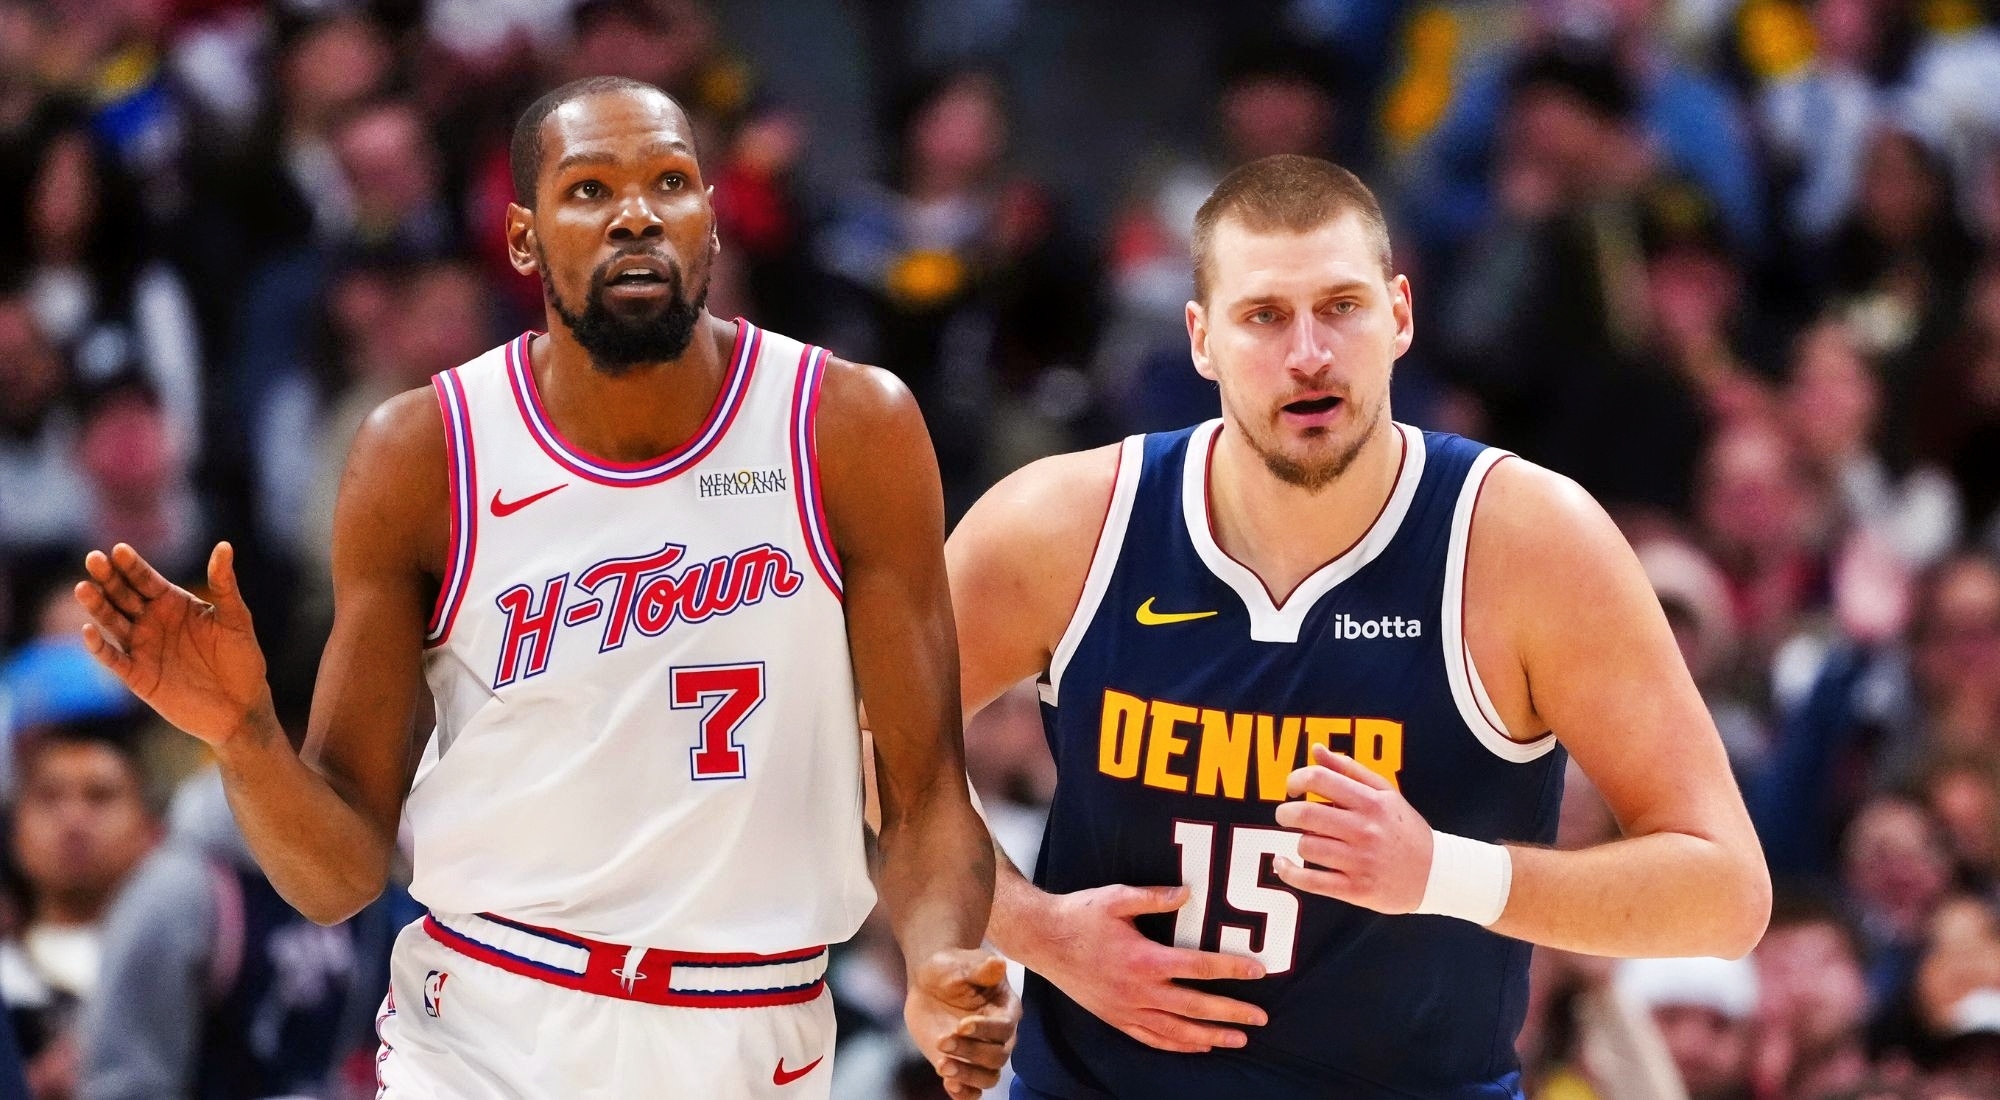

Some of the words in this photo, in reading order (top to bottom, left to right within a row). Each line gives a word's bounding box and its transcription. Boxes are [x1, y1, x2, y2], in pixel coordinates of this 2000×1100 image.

[700, 468, 786, 487] MEMORIAL
[700, 480, 786, 498] HERMANN
[493, 542, 804, 689] H-Town
[1335, 613, 1422, 640] ibotta
[669, 661, 766, 780] 7
[1172, 817, 1306, 977] 15
